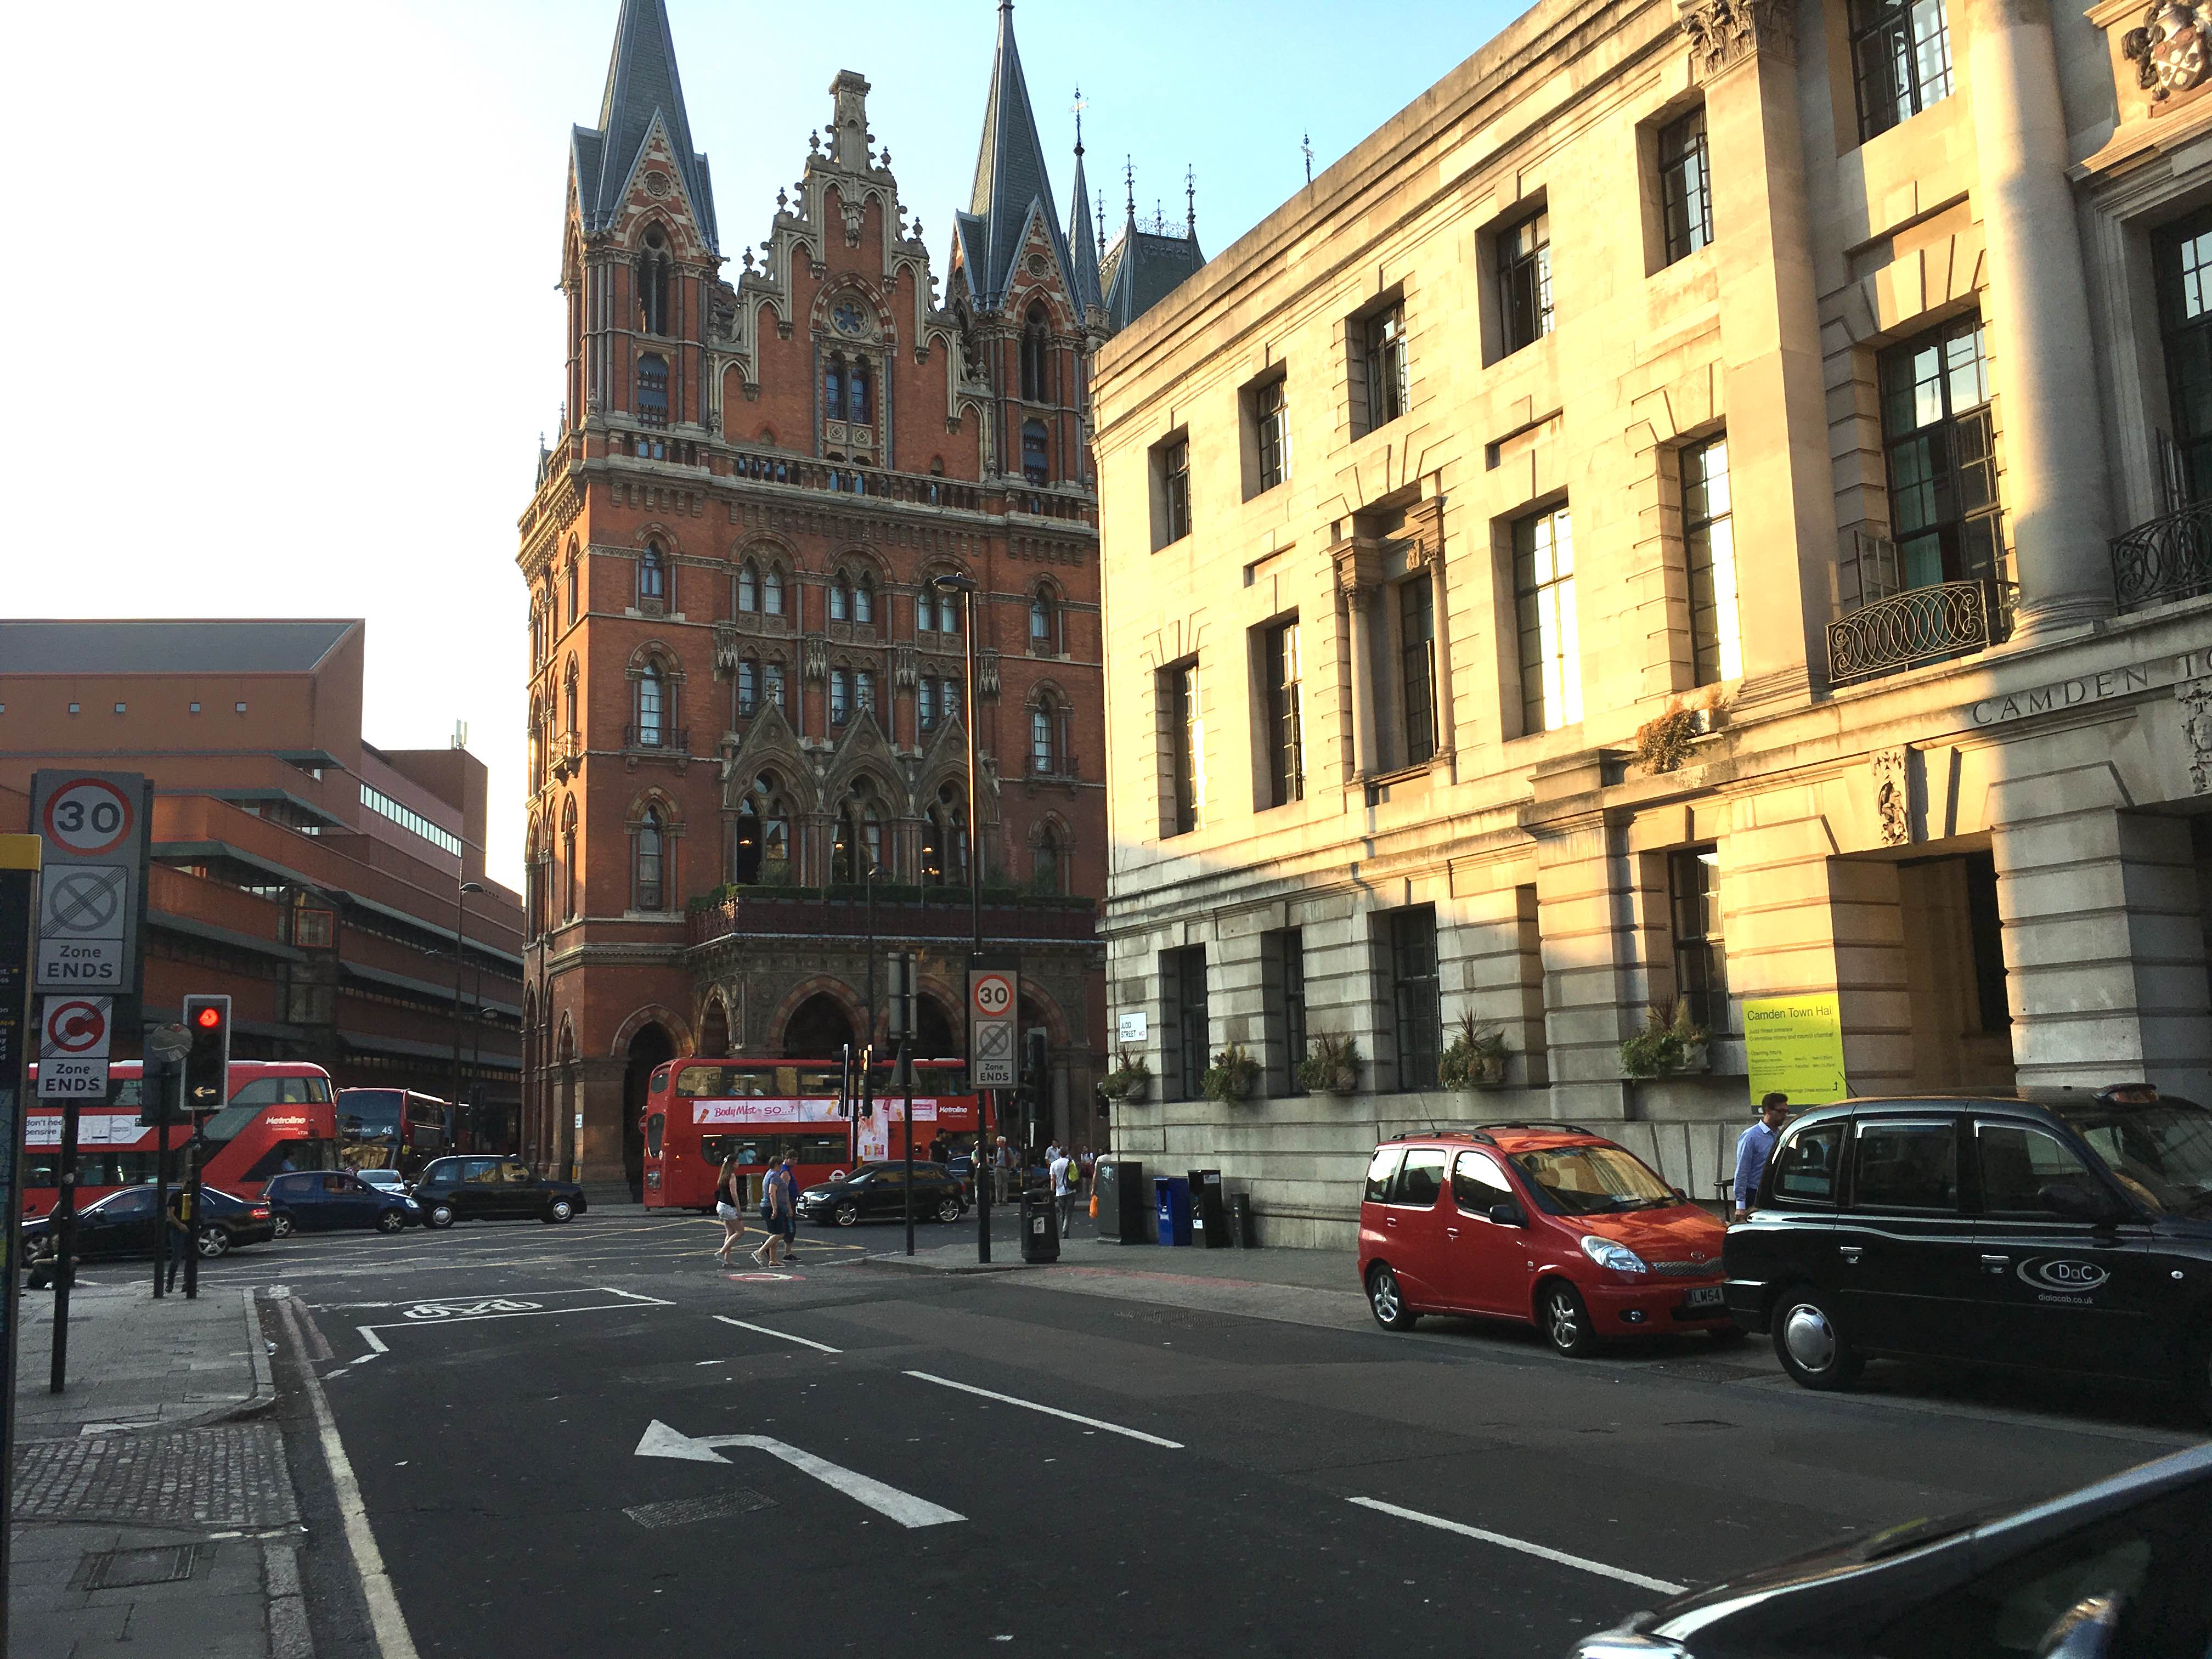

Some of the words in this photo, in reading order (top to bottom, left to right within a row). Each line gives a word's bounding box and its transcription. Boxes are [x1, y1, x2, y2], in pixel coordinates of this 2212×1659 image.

[1972, 664, 2148, 725] CAMDEN
[2176, 646, 2212, 678] T
[57, 800, 121, 834] 30
[60, 945, 101, 958] Zone
[47, 962, 113, 978] ENDS
[980, 986, 1008, 1004] 30
[1747, 1009, 1786, 1020] Camden
[1787, 1007, 1813, 1018] Town
[1121, 1030, 1136, 1038] STREET
[55, 1063, 91, 1074] Zone
[980, 1072, 1009, 1081] ENDS
[45, 1077, 101, 1092] ENDS
[714, 1107, 736, 1117] Body
[736, 1105, 756, 1115] Mist
[266, 1116, 306, 1124] Metroline
[382, 1126, 392, 1135] 45
[2059, 1264, 2092, 1280] DaC
[2038, 1293, 2094, 1305] dialacab.co.uk
